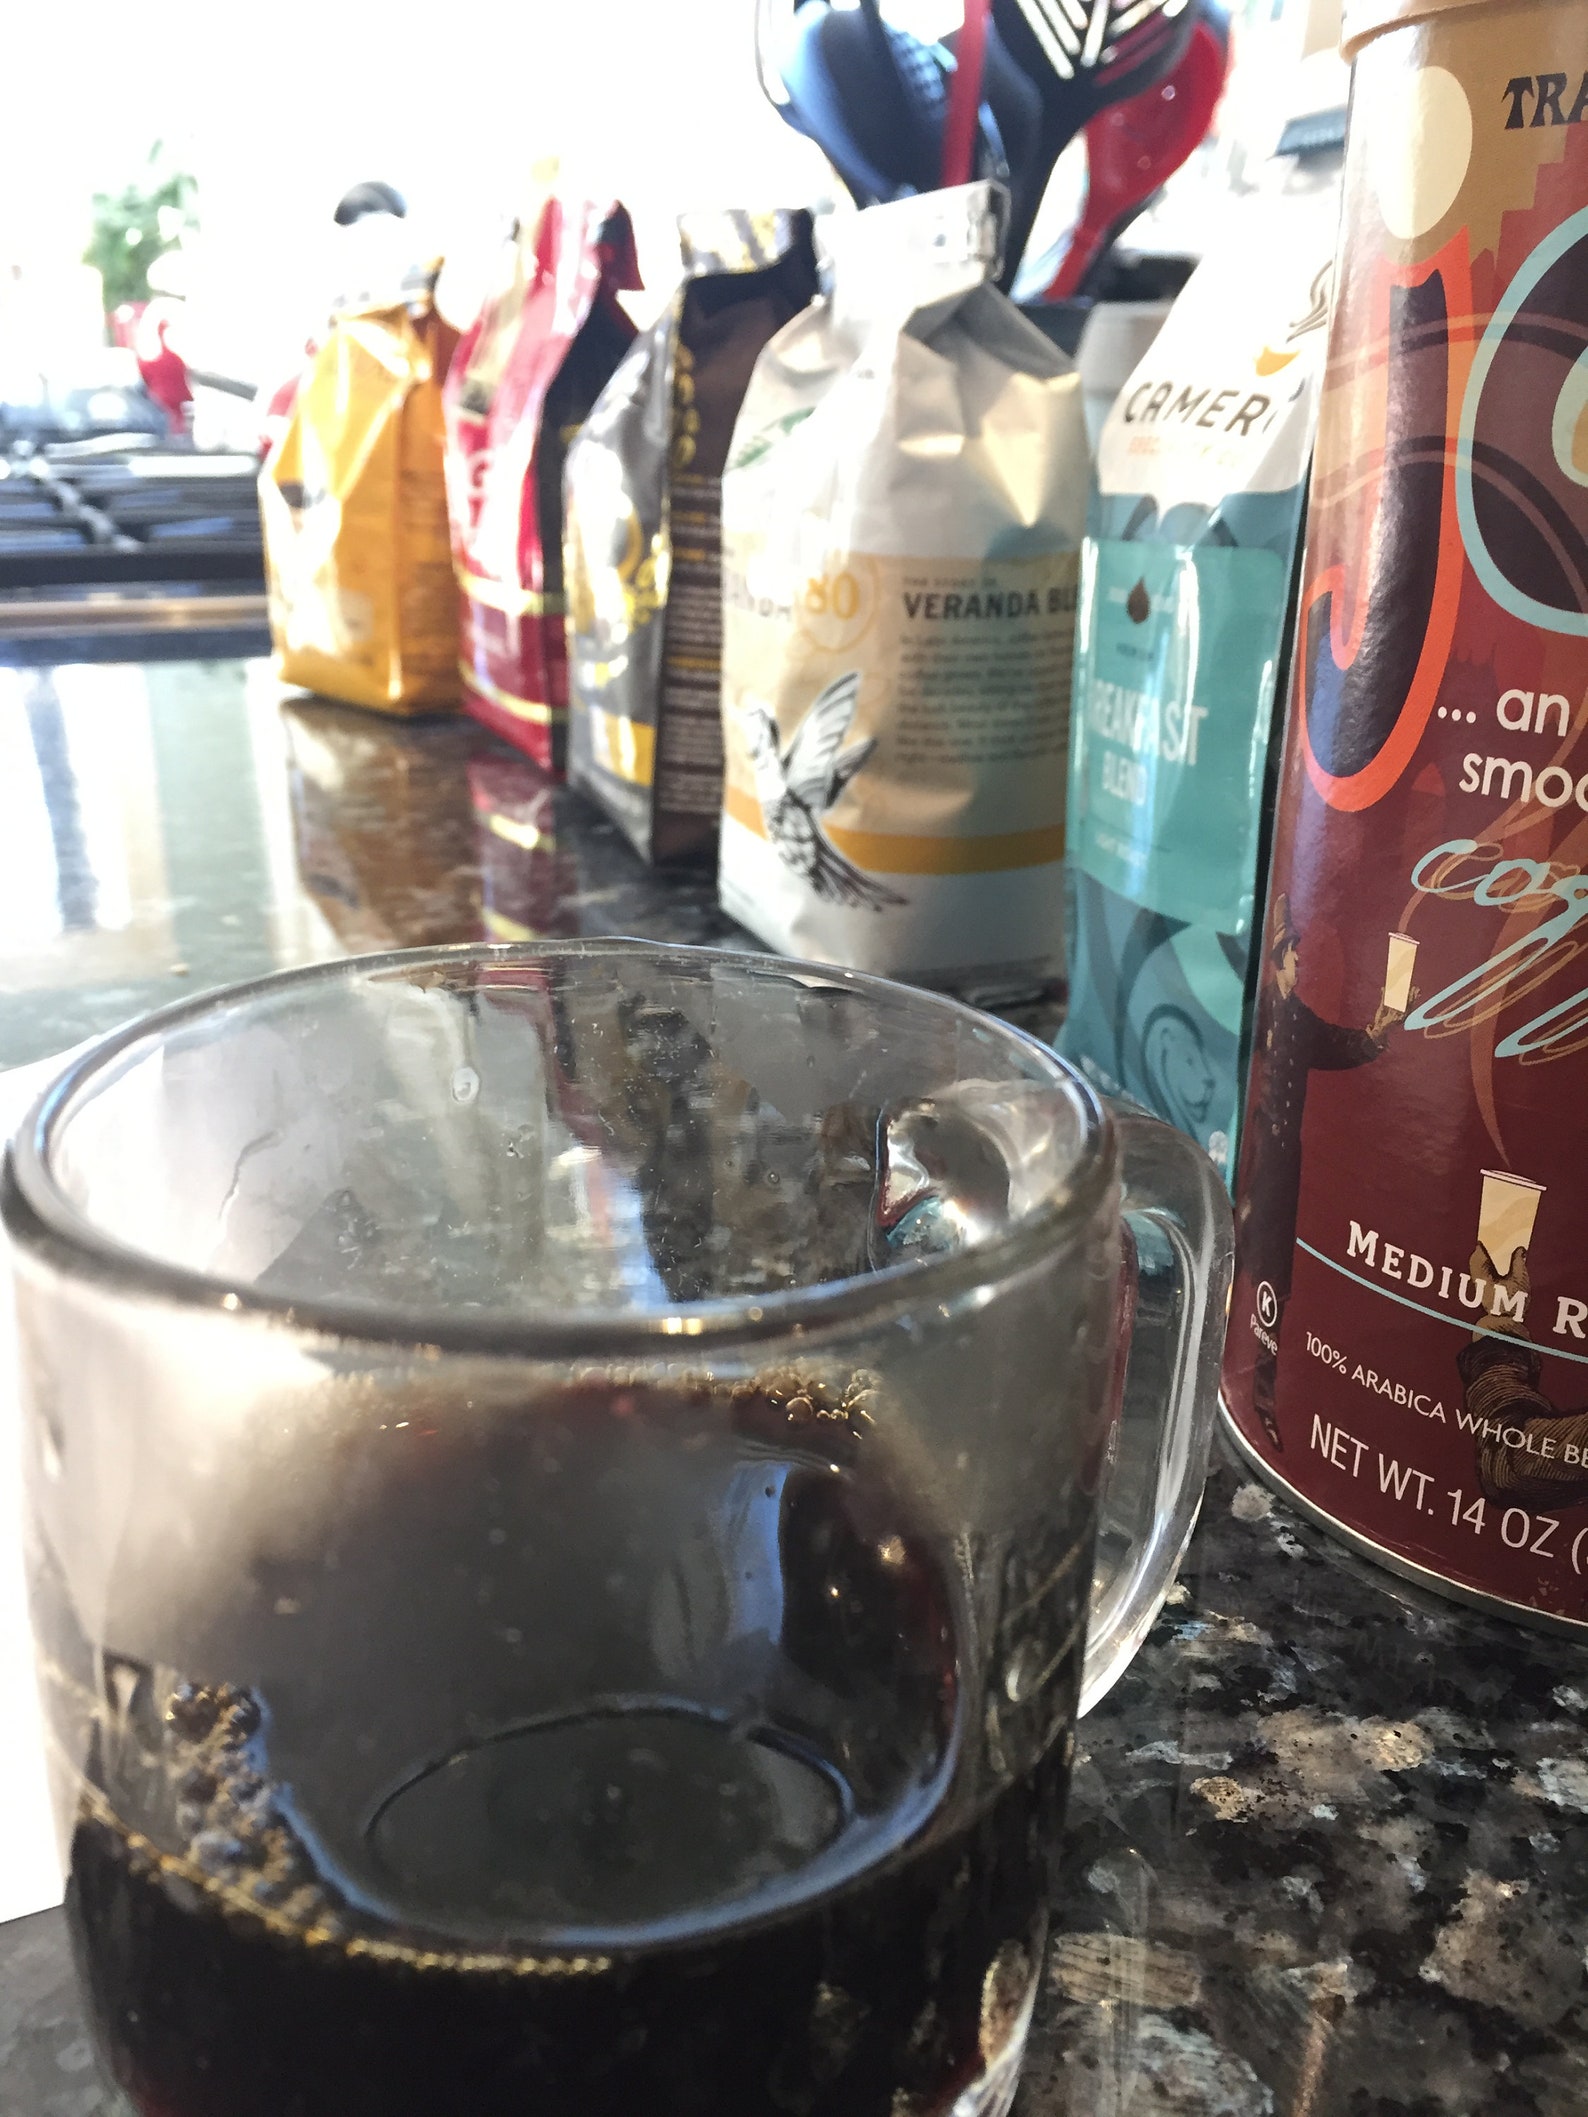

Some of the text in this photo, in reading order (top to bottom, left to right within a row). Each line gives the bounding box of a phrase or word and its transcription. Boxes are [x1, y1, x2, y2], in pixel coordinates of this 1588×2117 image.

[1123, 378, 1306, 437] CAMER
[903, 588, 1040, 620] VERANDA
[1496, 688, 1570, 737] an
[1347, 1220, 1530, 1323] MEDIUM
[1250, 1313, 1278, 1356] Pareve
[1306, 1331, 1348, 1374] 100%
[1351, 1364, 1446, 1424] ARABICA
[1455, 1408, 1557, 1460] WHOLE
[1310, 1413, 1369, 1478] NET
[1378, 1452, 1435, 1516] WT.
[1447, 1488, 1486, 1535] 14
[1501, 1507, 1560, 1558] OZ
